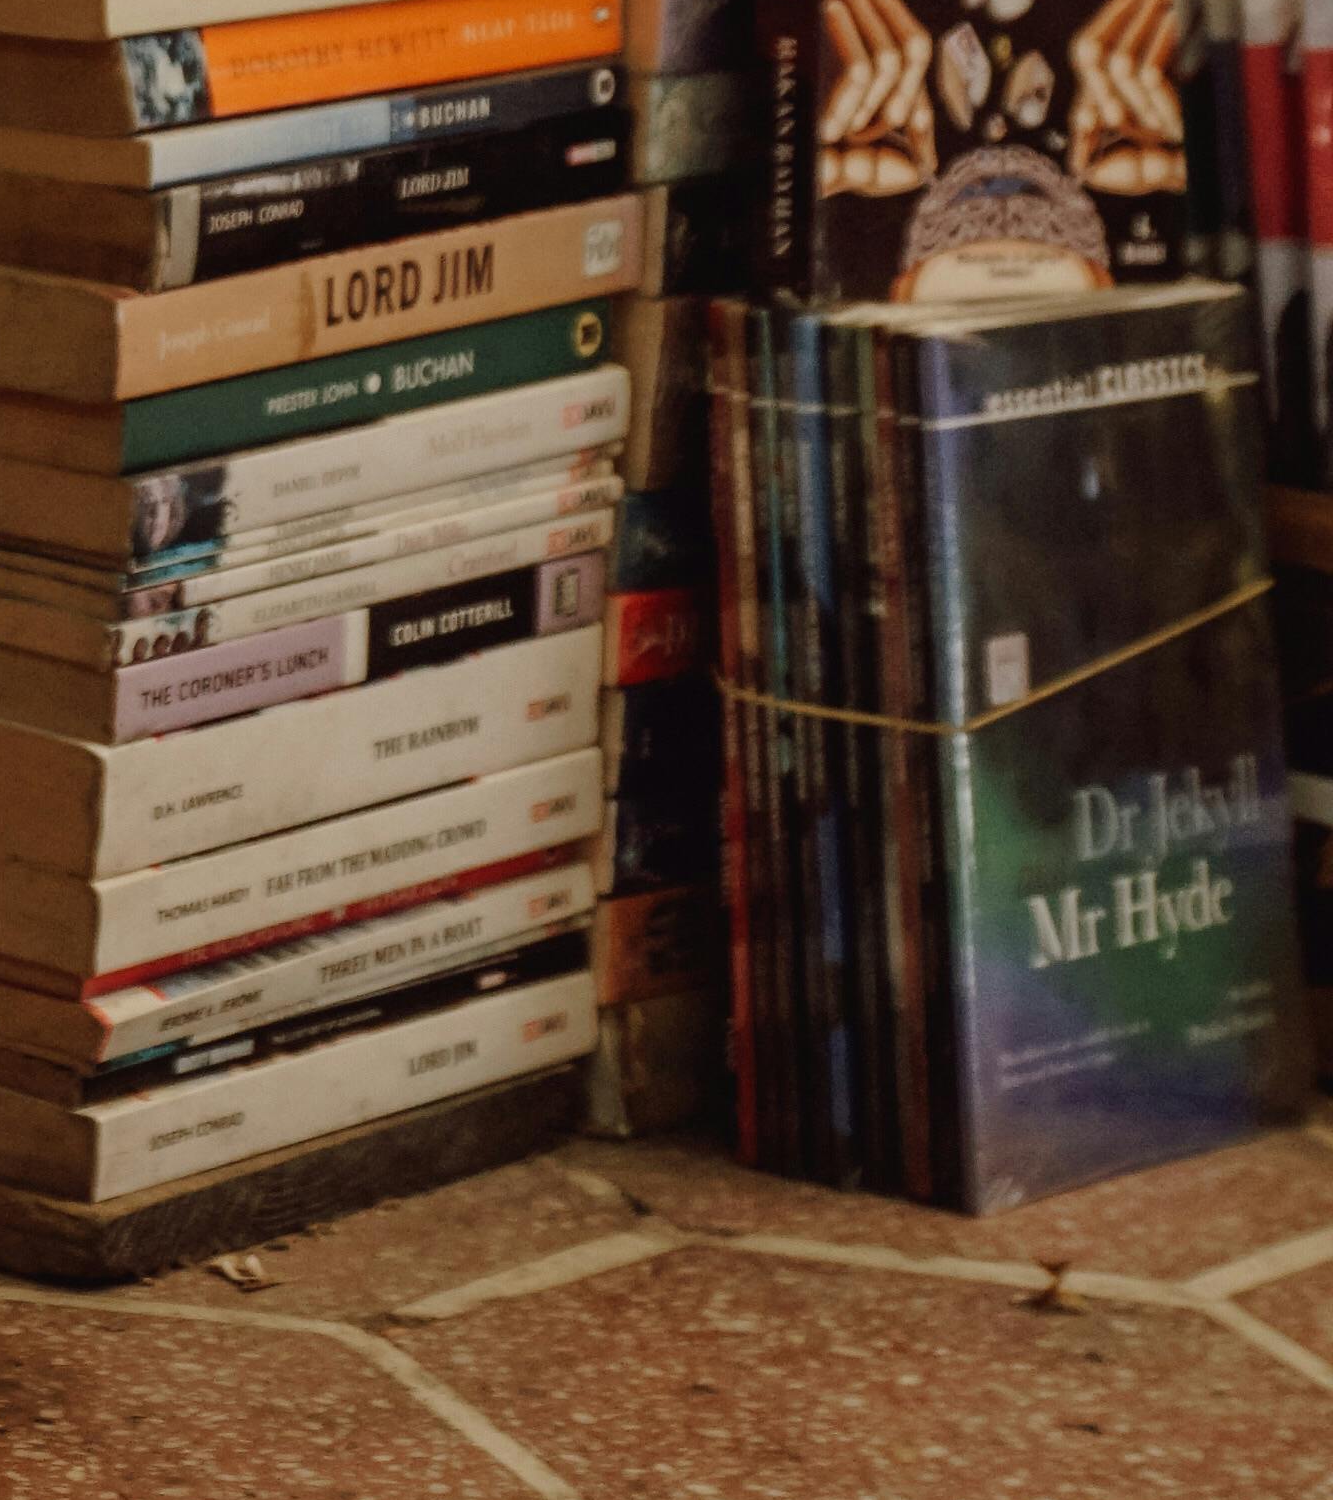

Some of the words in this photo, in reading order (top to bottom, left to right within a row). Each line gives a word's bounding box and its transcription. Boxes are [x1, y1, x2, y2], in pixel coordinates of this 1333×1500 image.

[418, 96, 492, 127] BUCHAN
[208, 207, 254, 237] JOSEPH
[257, 200, 306, 226] CONRAD
[398, 172, 443, 200] LORD
[324, 261, 422, 329] LORD
[431, 242, 496, 306] JIM
[389, 351, 476, 394] BUCHAN
[140, 686, 172, 710] THE
[178, 663, 270, 699] CORONER'S
[275, 648, 330, 677] LUNCH
[389, 621, 434, 647] COLIN
[438, 599, 513, 637] COTTERILL
[373, 736, 409, 762] THE
[418, 717, 480, 751] RAINBOW
[1072, 783, 1140, 863] Dr
[297, 862, 337, 888] FROM
[340, 852, 367, 880] THE
[1026, 888, 1107, 969] Mr
[1112, 858, 1233, 960] Hyde
[317, 951, 365, 983] THREE
[373, 938, 409, 966] MEN
[442, 917, 483, 945] BOAT
